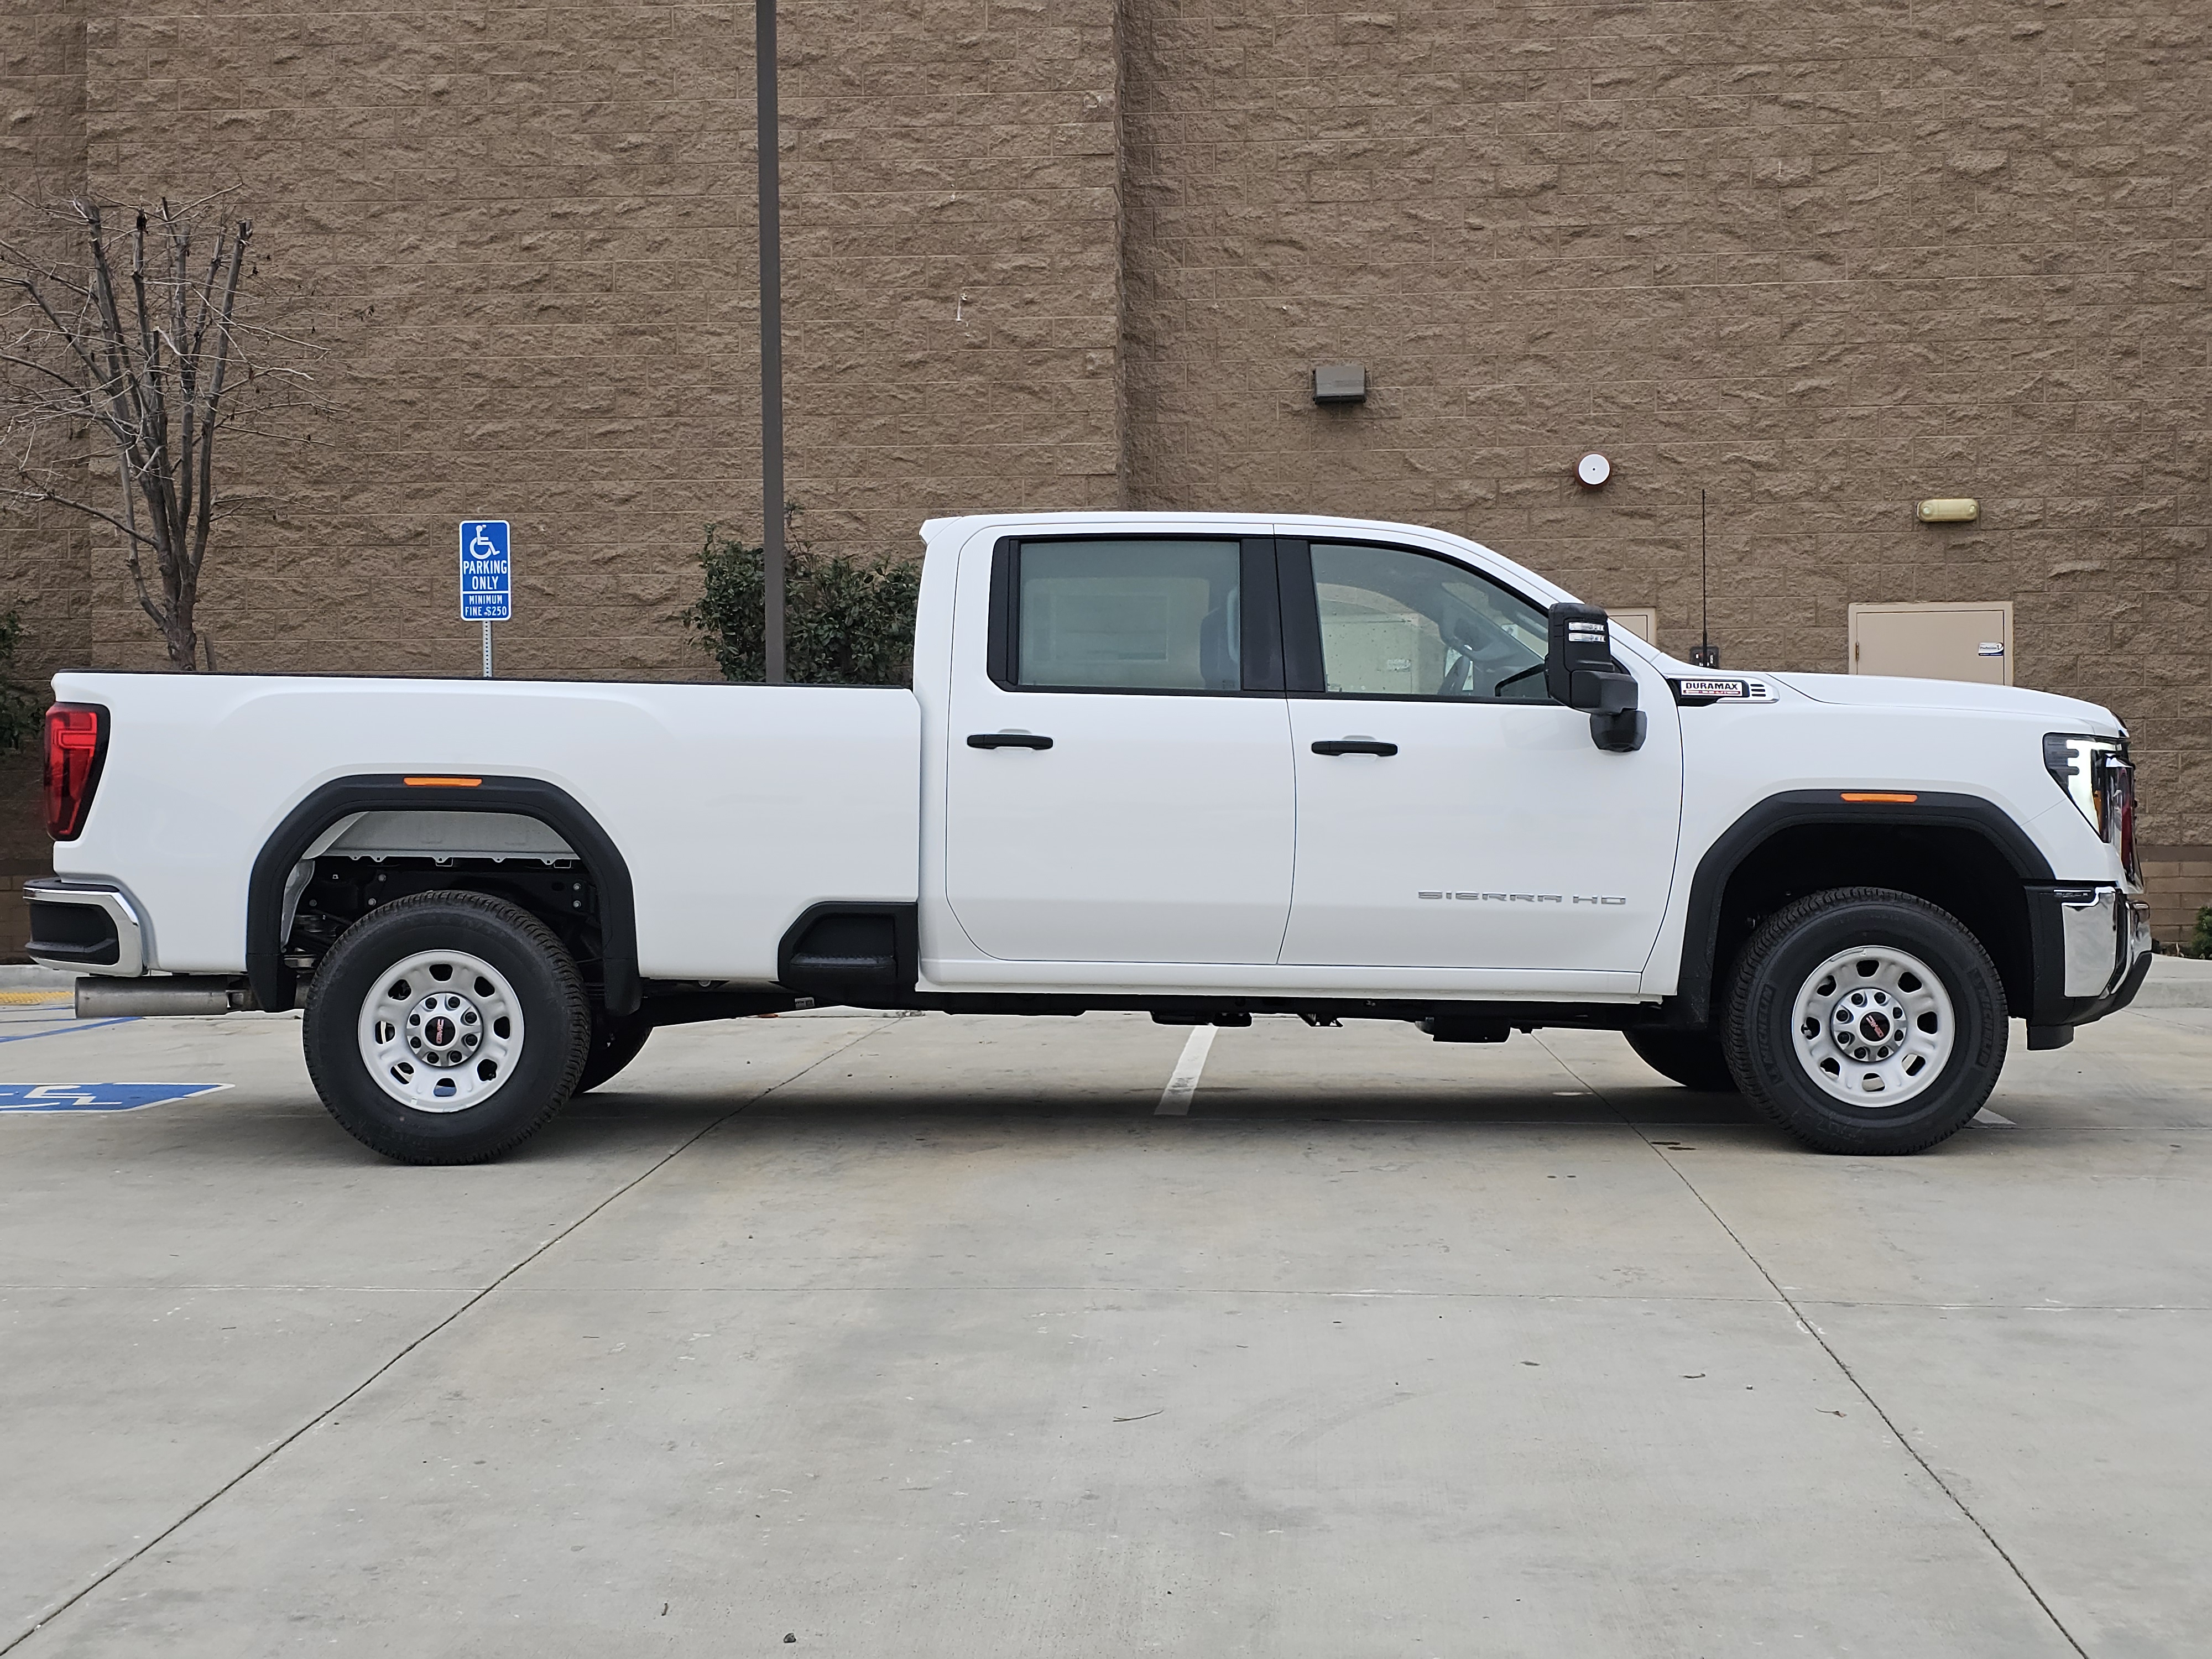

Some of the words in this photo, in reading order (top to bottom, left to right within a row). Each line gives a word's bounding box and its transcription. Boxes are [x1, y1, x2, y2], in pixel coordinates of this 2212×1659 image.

[463, 560, 507, 575] PARKING
[472, 576, 499, 590] ONLY
[469, 594, 503, 605] MINIMUM
[465, 606, 482, 616] FINE
[1418, 890, 1562, 902] SIERRA
[1573, 894, 1626, 905] HD
[1866, 1015, 1885, 1038] GMC
